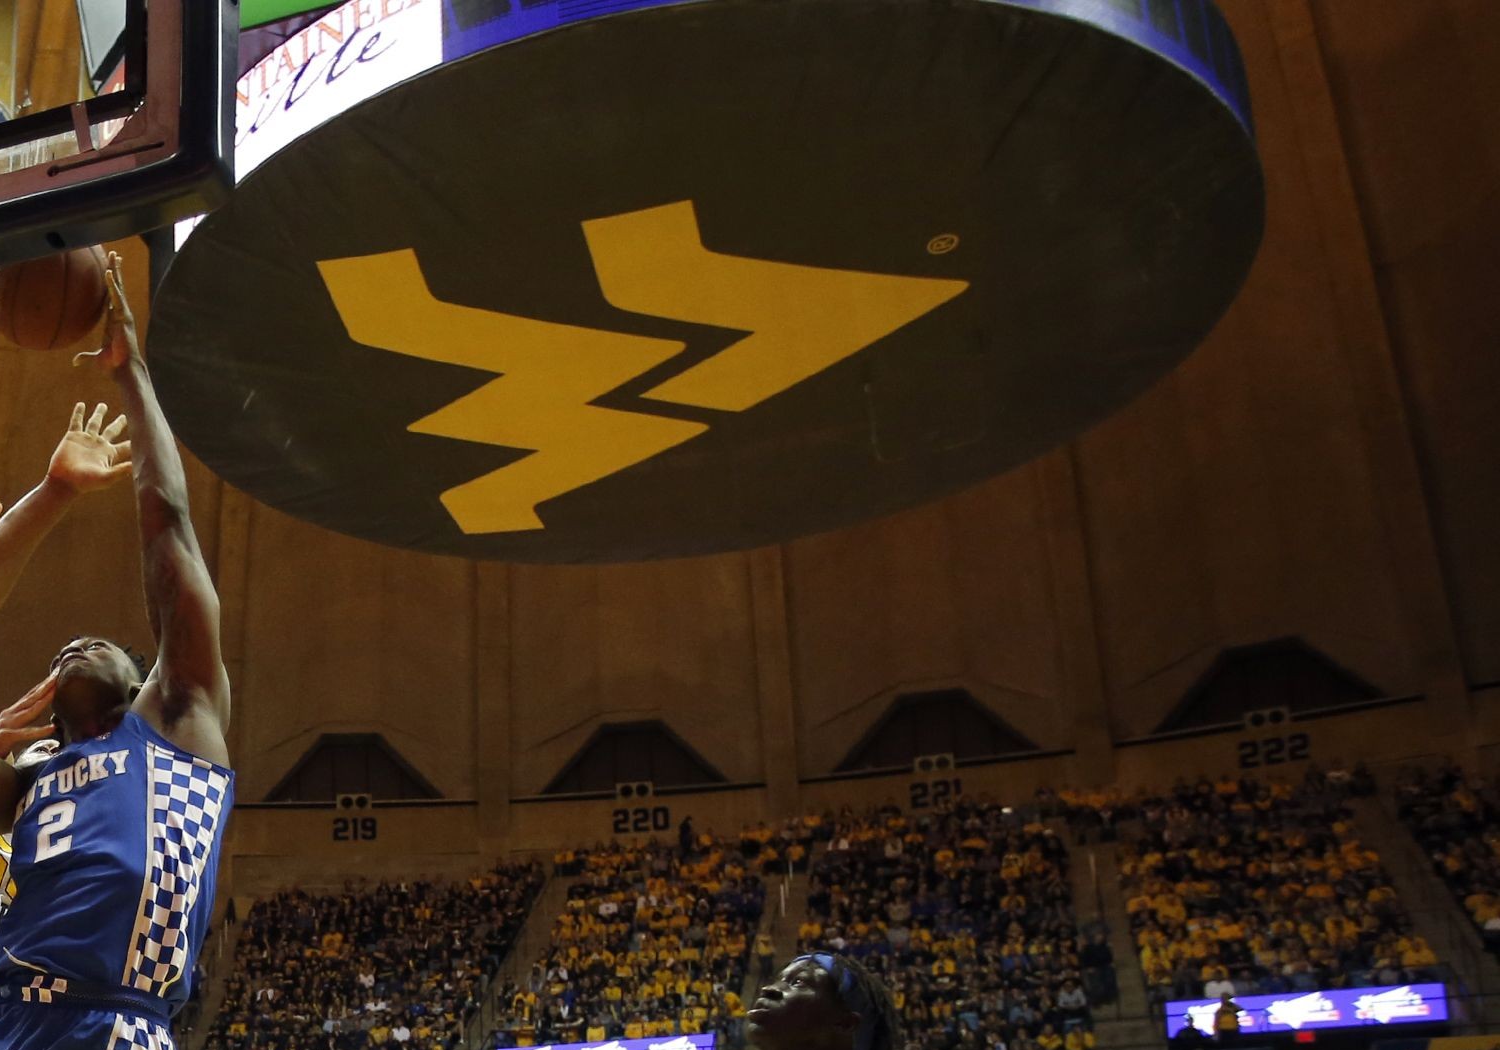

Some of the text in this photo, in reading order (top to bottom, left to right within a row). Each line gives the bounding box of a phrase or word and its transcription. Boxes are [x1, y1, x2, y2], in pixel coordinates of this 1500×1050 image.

[1238, 734, 1311, 769] 222
[909, 780, 962, 809] 221
[34, 799, 77, 864] 2
[332, 817, 378, 842] 219
[613, 807, 670, 835] 220
